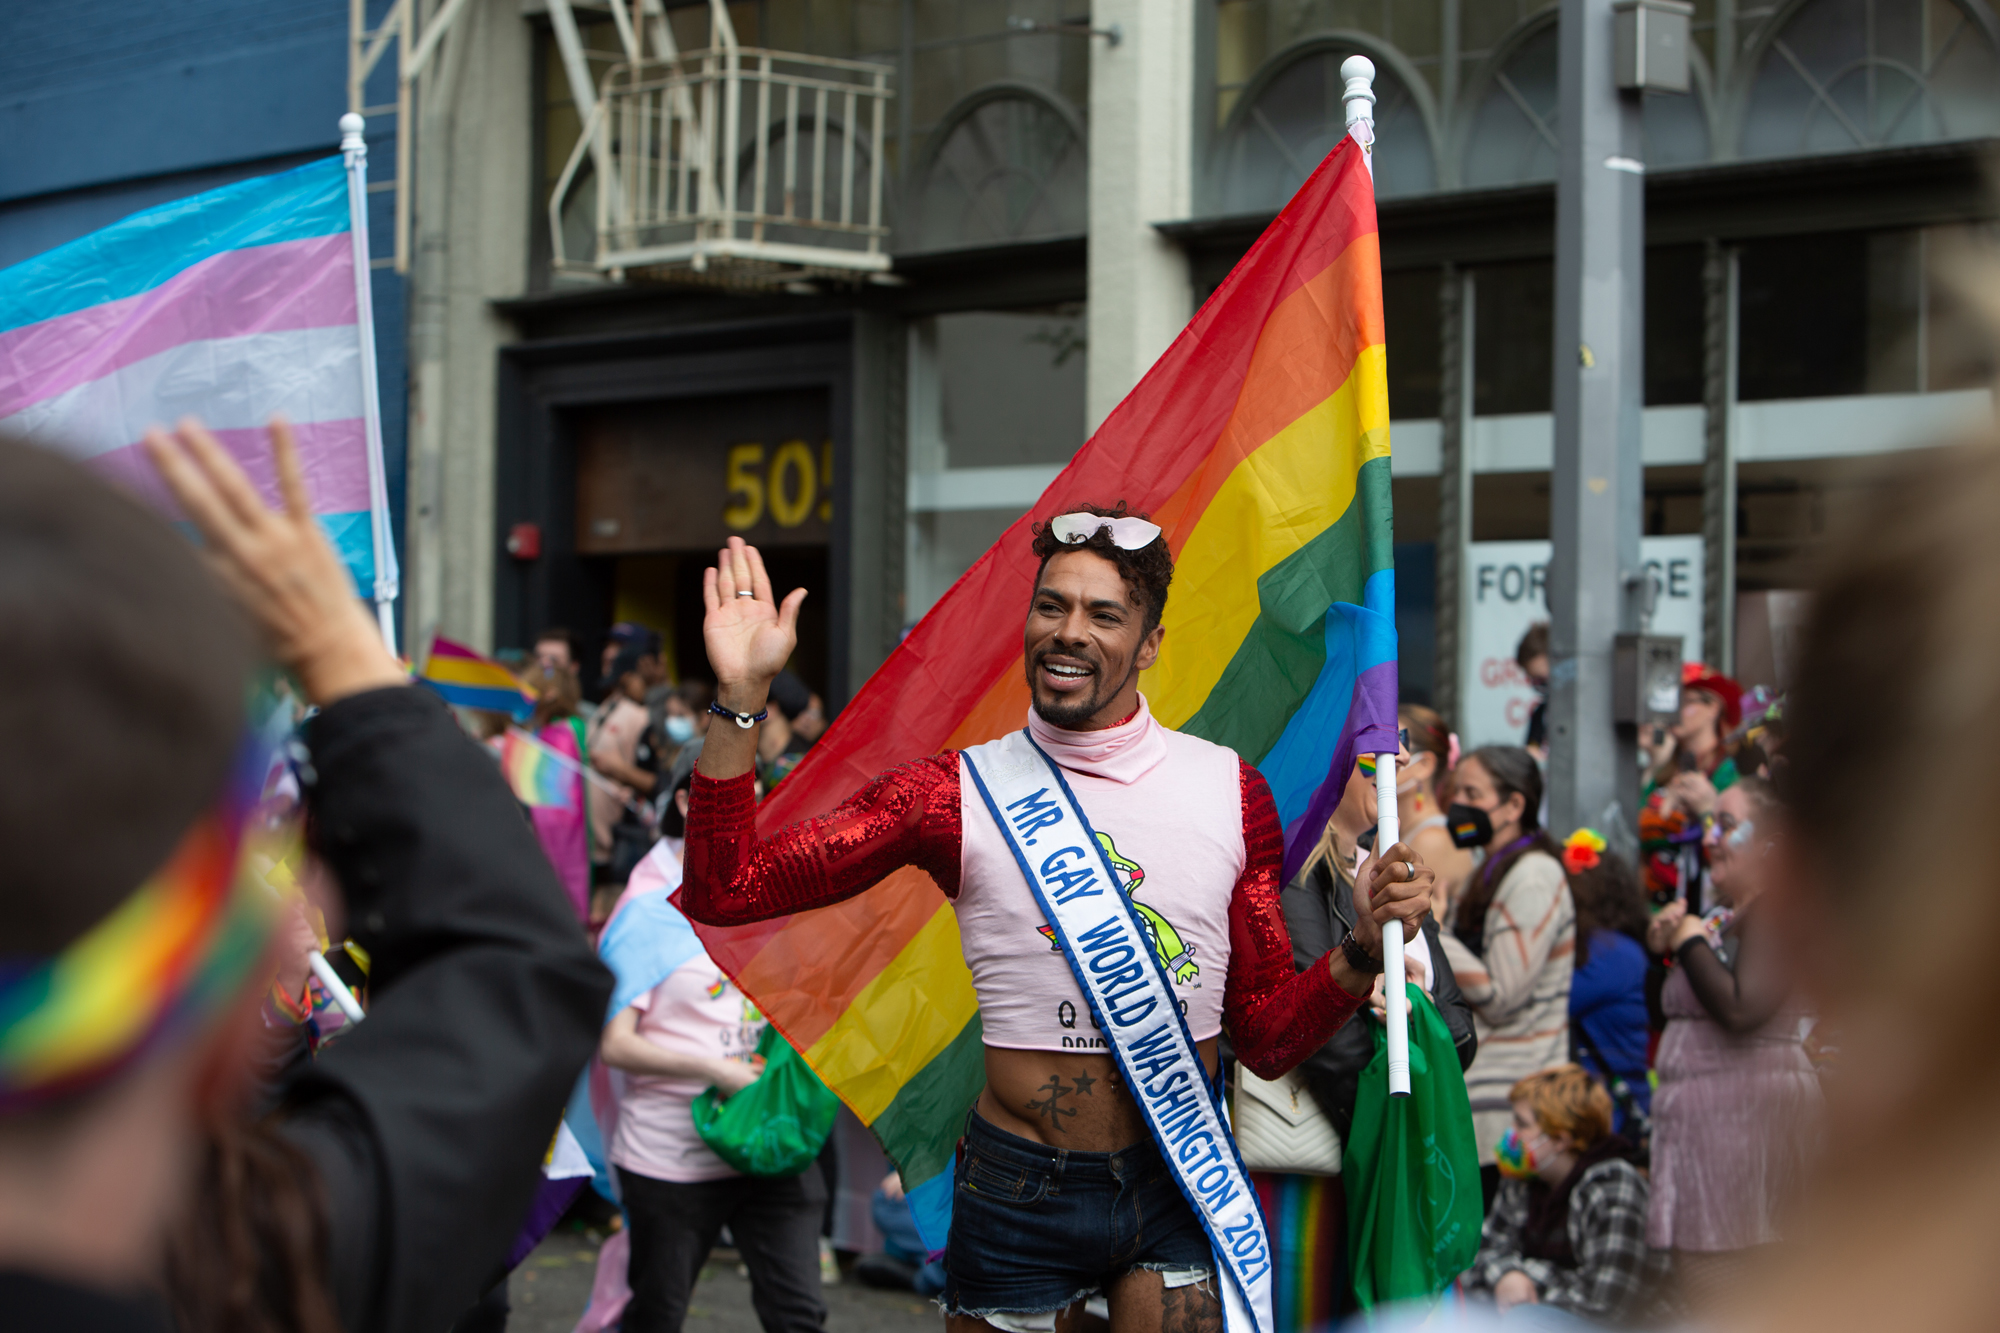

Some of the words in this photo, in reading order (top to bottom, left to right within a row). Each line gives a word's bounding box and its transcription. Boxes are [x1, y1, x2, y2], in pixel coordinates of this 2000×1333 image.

[725, 441, 833, 530] 50
[1005, 787, 1064, 847] MR.
[1040, 845, 1104, 906] GAY
[1076, 915, 1159, 1028] WORLD
[1126, 1023, 1241, 1215] WASHINGTON
[1222, 1212, 1270, 1286] 2021
[1058, 1000, 1076, 1029] Q
